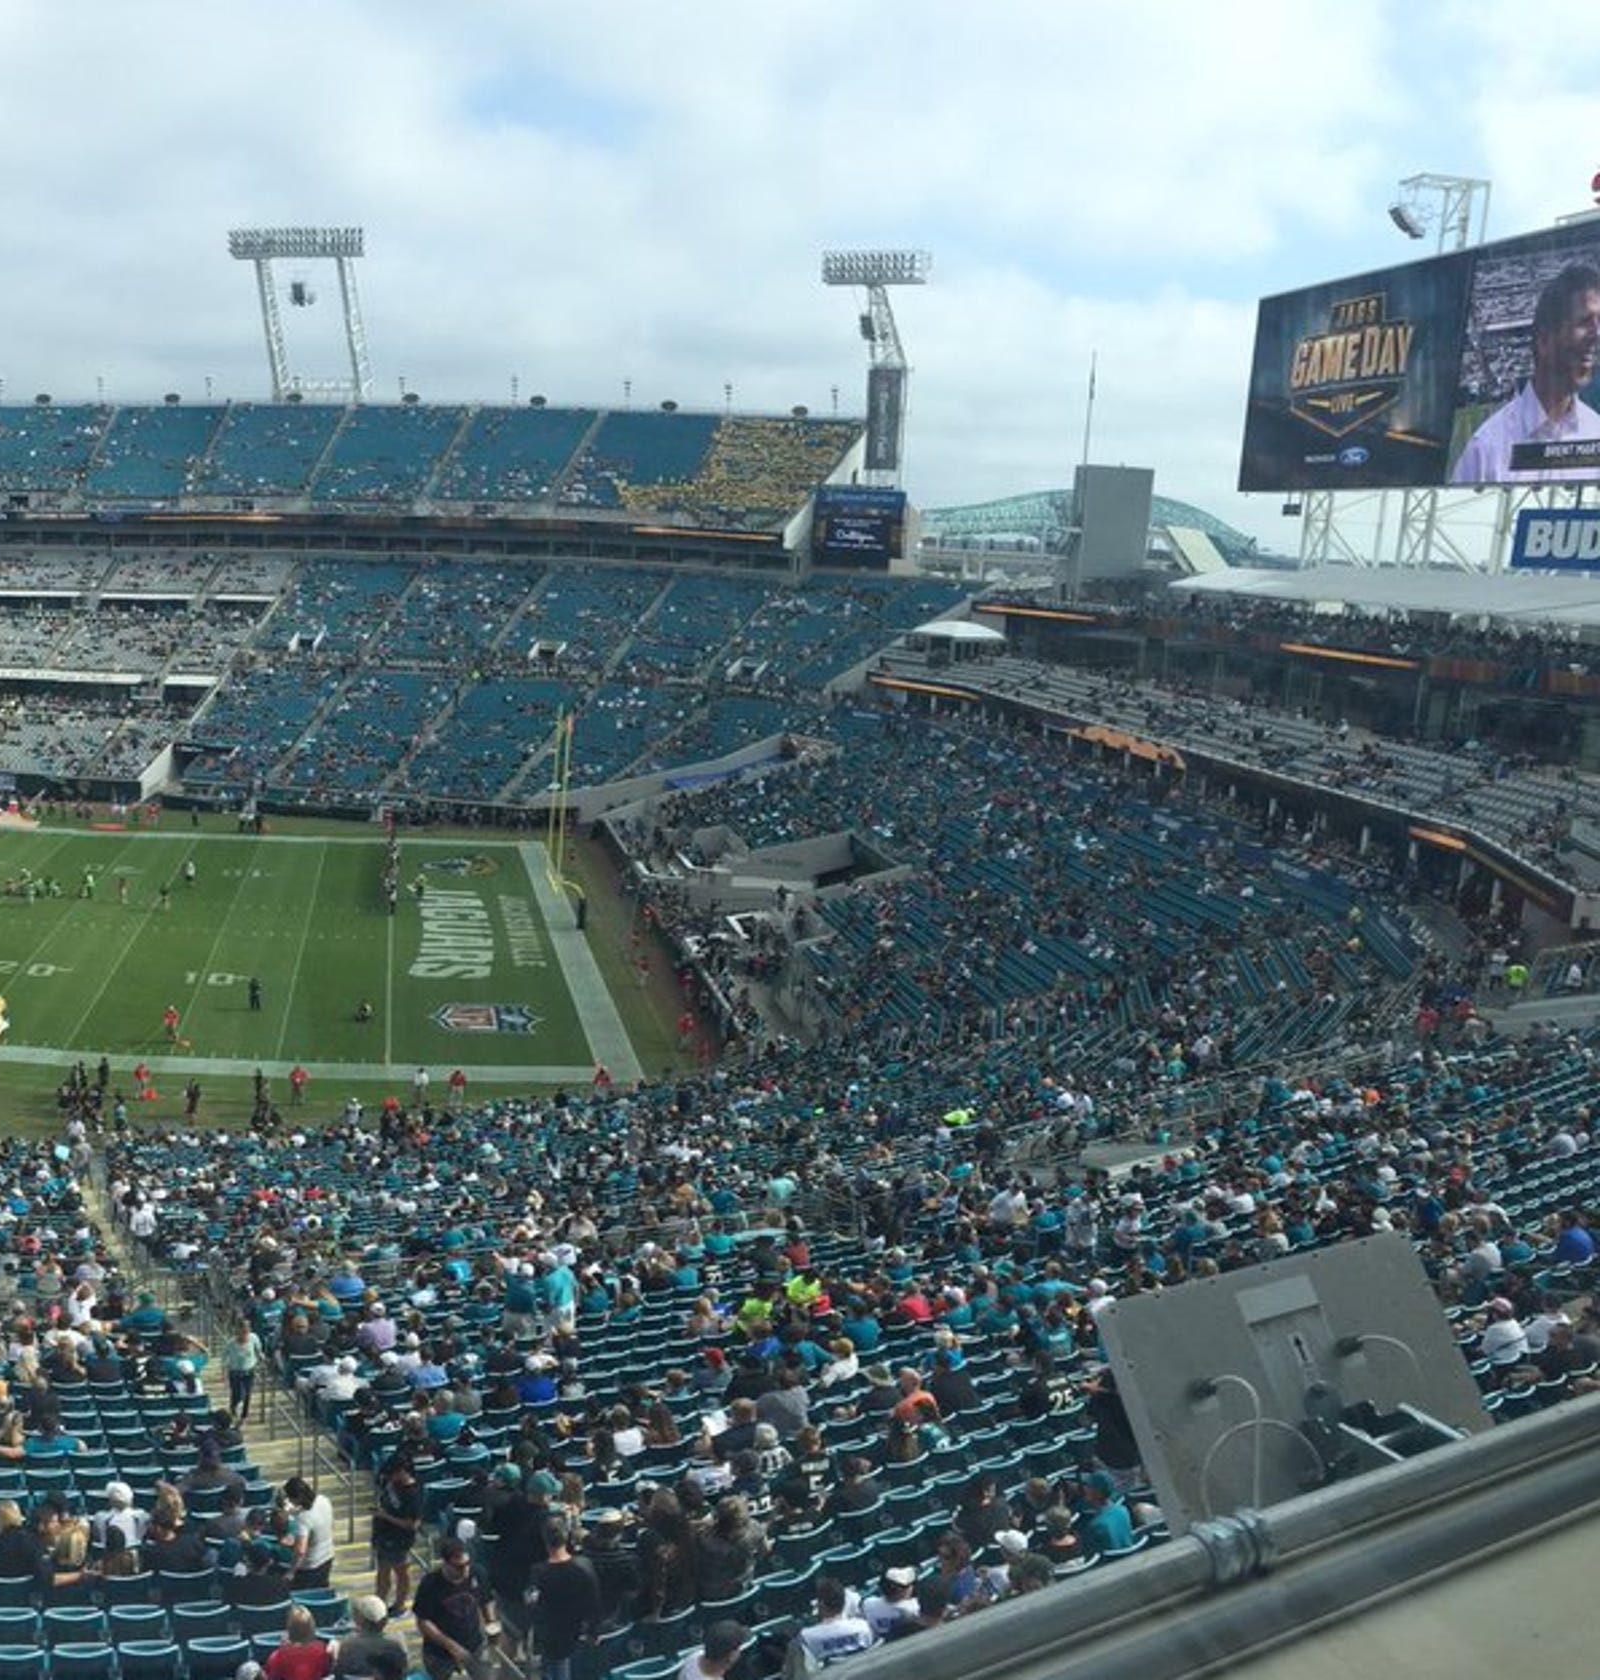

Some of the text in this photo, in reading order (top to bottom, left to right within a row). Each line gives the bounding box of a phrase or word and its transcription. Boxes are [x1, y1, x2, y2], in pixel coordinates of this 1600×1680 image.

[1523, 520, 1600, 560] BUD
[408, 887, 494, 979] JAGUARS
[184, 971, 235, 986] 10
